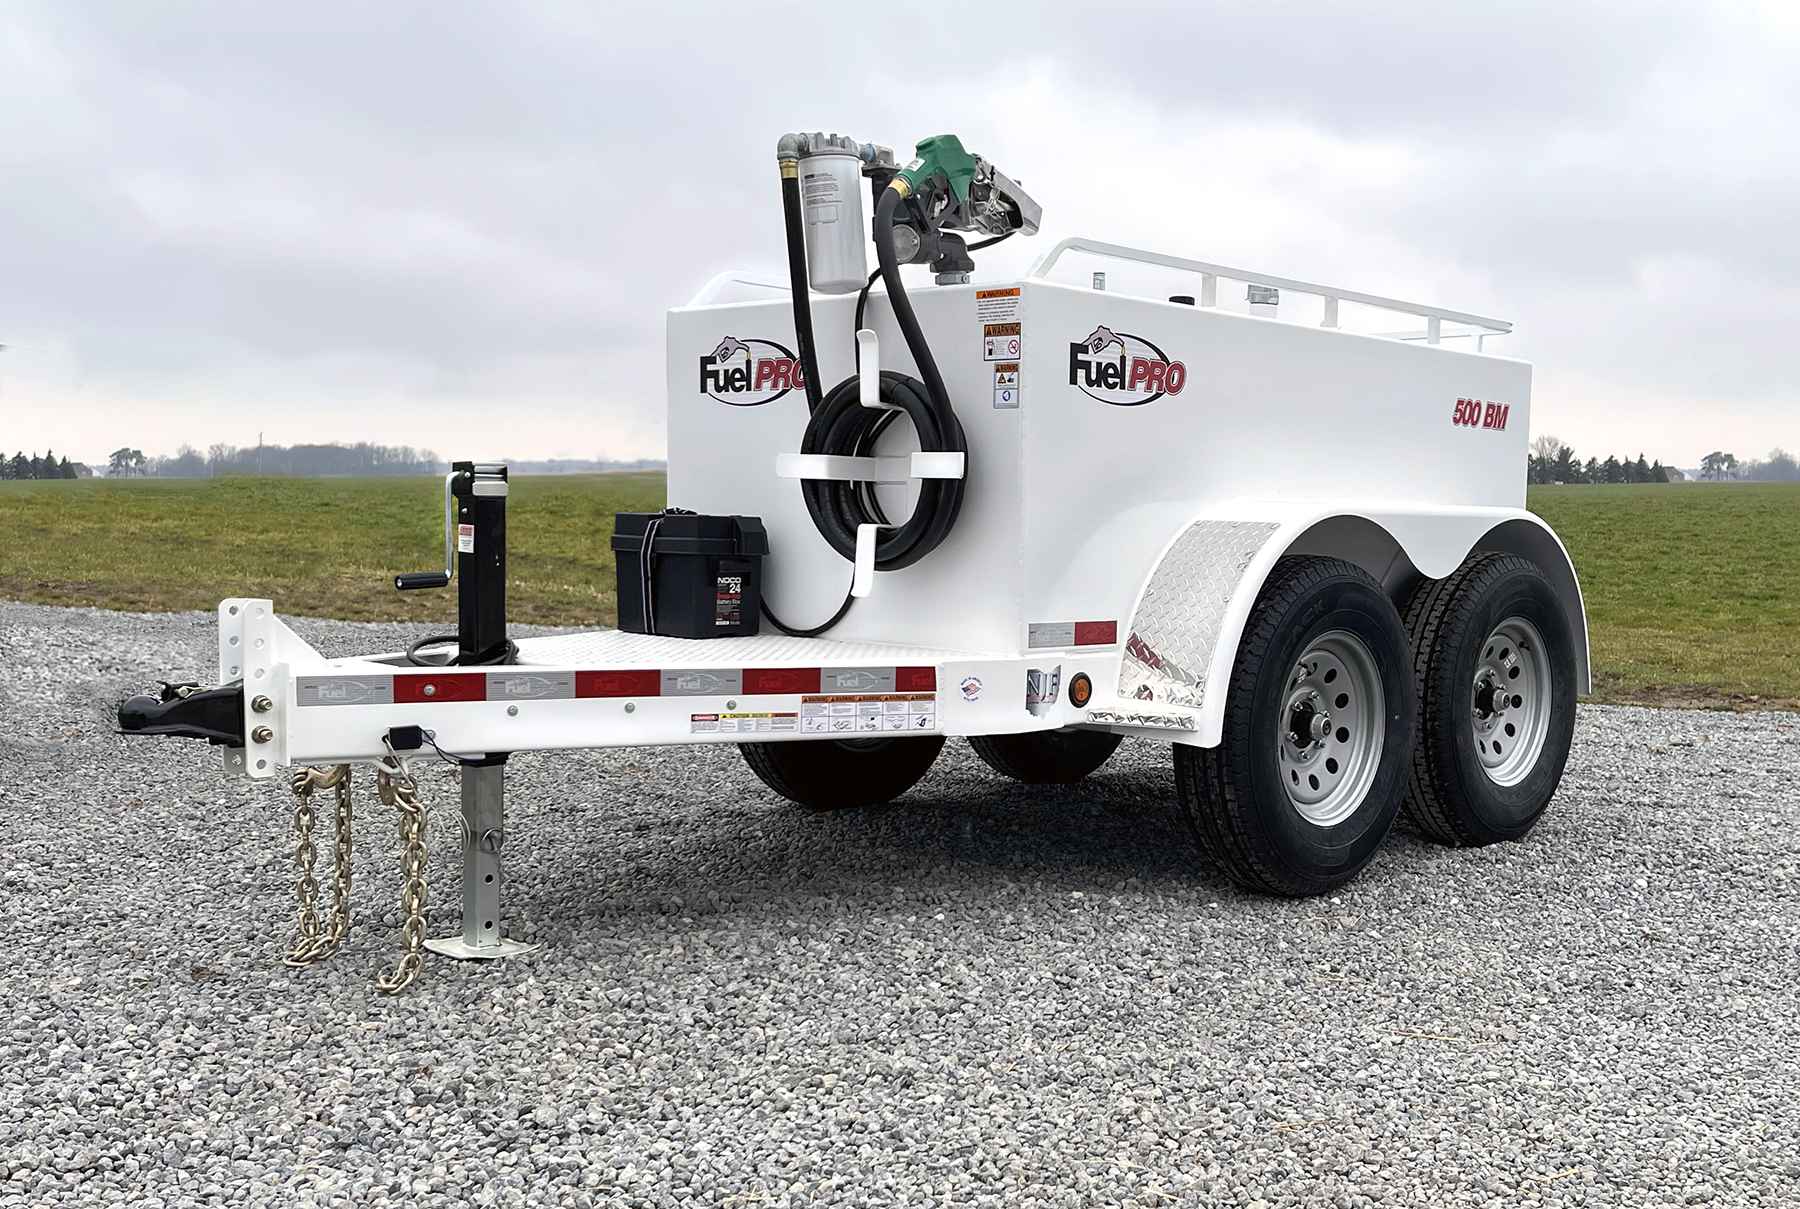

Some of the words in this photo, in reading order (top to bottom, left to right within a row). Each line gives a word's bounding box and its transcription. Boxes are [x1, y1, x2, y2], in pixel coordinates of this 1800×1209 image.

[992, 324, 1020, 336] WARNING
[1452, 398, 1482, 427] 500
[1482, 401, 1510, 431] BM
[729, 583, 742, 593] 24
[504, 679, 531, 694] Fuel
[836, 673, 860, 688] Fuel
